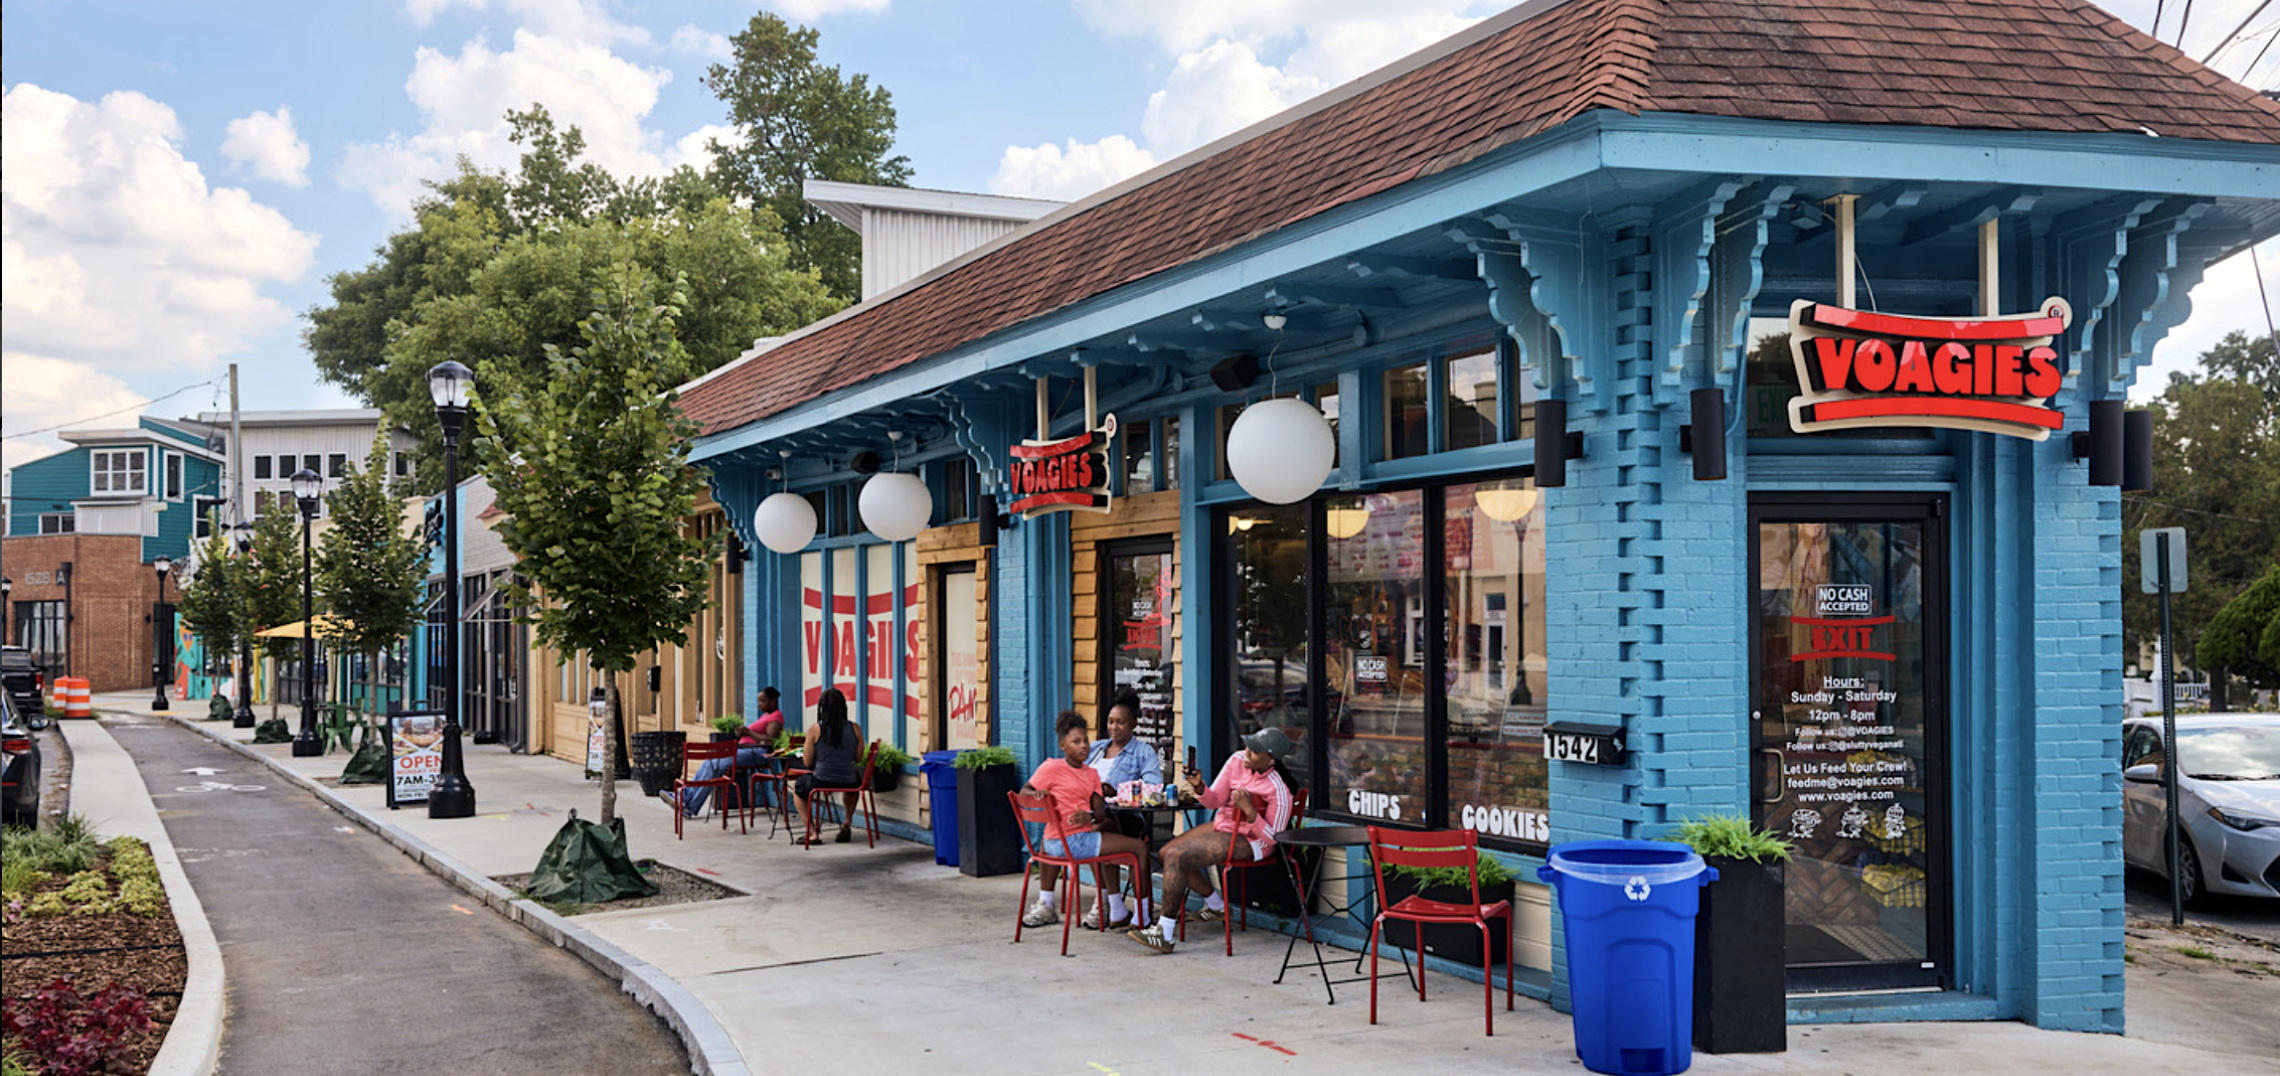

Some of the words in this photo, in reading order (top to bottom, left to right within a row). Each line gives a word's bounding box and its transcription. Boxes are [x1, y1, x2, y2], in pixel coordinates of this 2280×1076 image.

[1813, 336, 2062, 397] VOAGIES
[1010, 452, 1092, 495] VOAGIES
[1820, 588, 1836, 601] NO
[1838, 588, 1868, 601] CASH
[1820, 602, 1869, 611] ACCEPTED
[1813, 627, 1873, 650] EXIT
[1358, 659, 1368, 670] NO
[1823, 676, 1865, 688] Hours:
[1791, 691, 1835, 705] Sunday
[1845, 690, 1897, 703] Saturday
[1809, 709, 1840, 722] 12pm
[1850, 709, 1875, 722] 8pm
[1795, 728, 1822, 736] Follow
[1548, 734, 1596, 762] 1542
[1787, 742, 1814, 750] Follow
[1784, 765, 1801, 775] Let
[1803, 764, 1818, 774] Us
[1821, 763, 1847, 773] Feed
[1849, 762, 1874, 773] Your
[1876, 761, 1908, 772] Crew!
[1787, 776, 1905, 789] feedme@voagies.com
[1798, 790, 1894, 804] www.voagies.com
[1348, 790, 1401, 820] CHIPS
[1462, 804, 1550, 842] COOKIES
